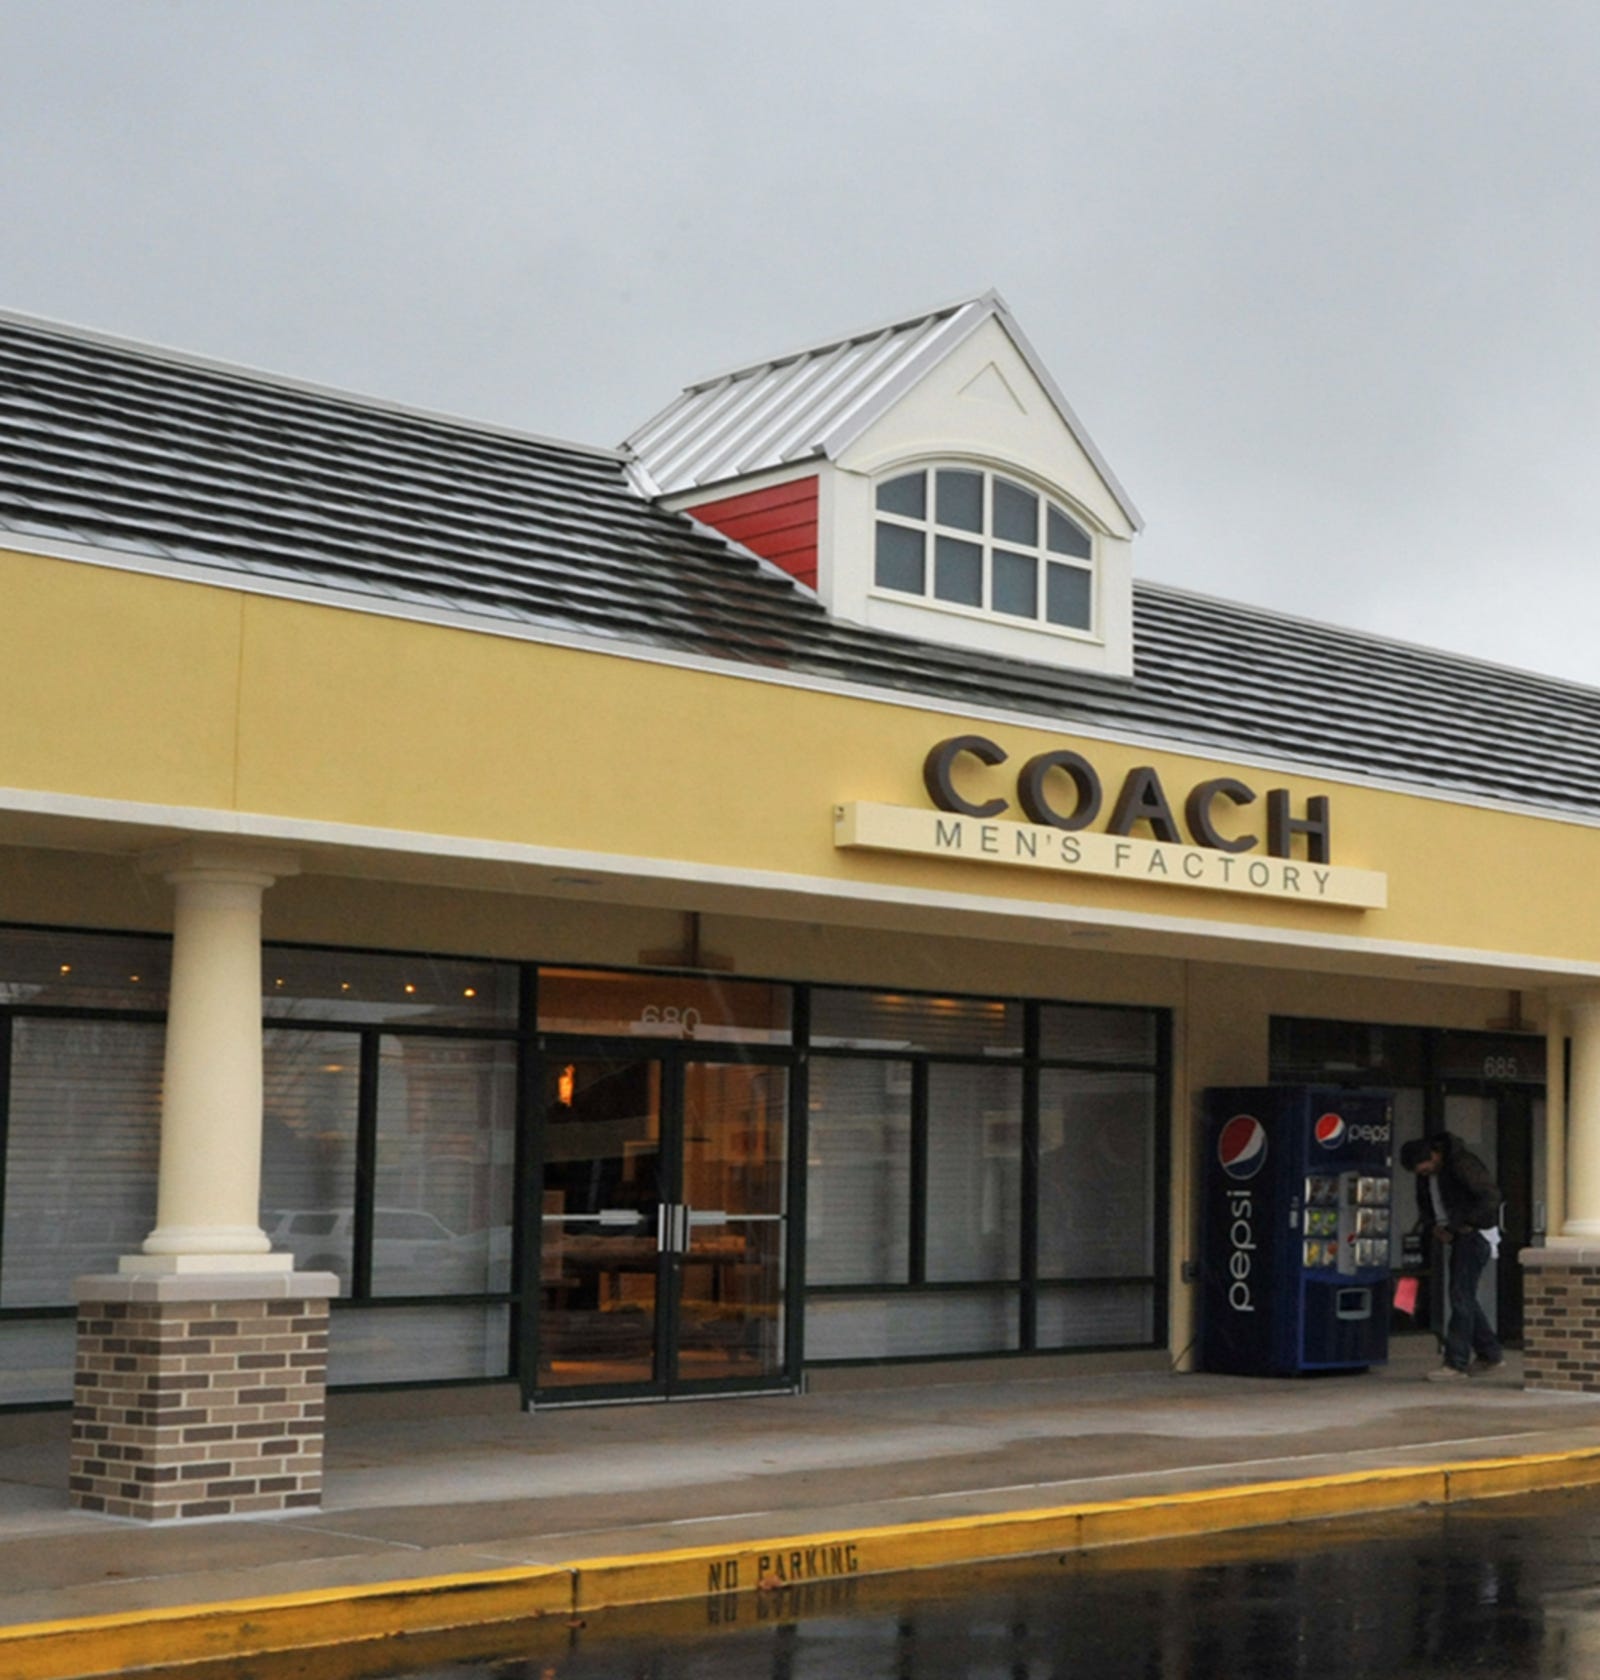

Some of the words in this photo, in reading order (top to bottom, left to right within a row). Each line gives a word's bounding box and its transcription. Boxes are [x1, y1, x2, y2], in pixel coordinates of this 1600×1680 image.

[922, 734, 1331, 865] COACH
[934, 819, 1082, 864] MEN'S
[1114, 842, 1332, 895] FACTORY
[640, 1004, 700, 1034] 680
[1483, 1055, 1517, 1078] 685
[1347, 1122, 1390, 1143] pepsi
[1228, 1190, 1256, 1311] pepsi
[708, 1560, 738, 1592] NO
[757, 1544, 858, 1586] PARKING
